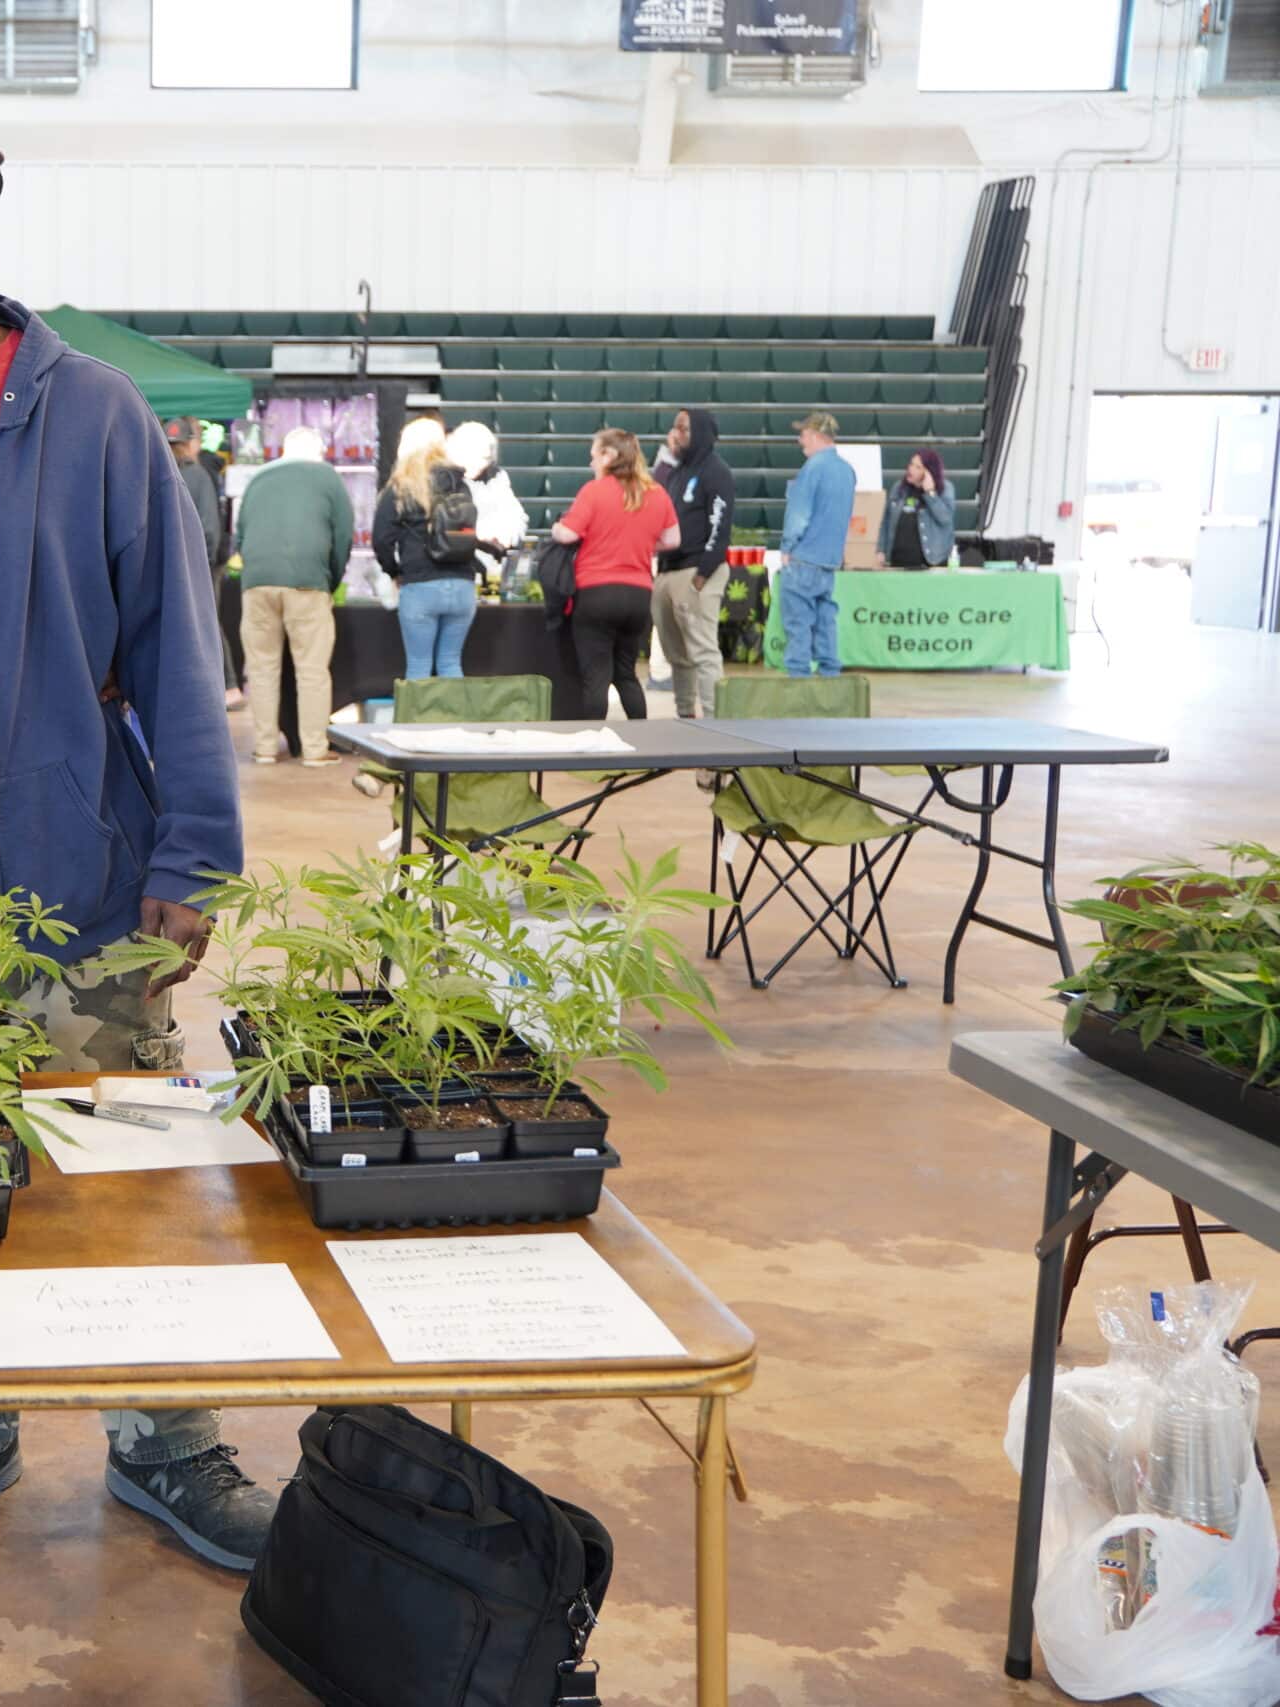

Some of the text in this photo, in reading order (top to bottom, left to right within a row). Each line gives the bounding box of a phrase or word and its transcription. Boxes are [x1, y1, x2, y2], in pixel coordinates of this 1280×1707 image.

[1195, 350, 1222, 369] EXIT
[853, 607, 1013, 625] Creative Care
[887, 635, 973, 652] Beacon
